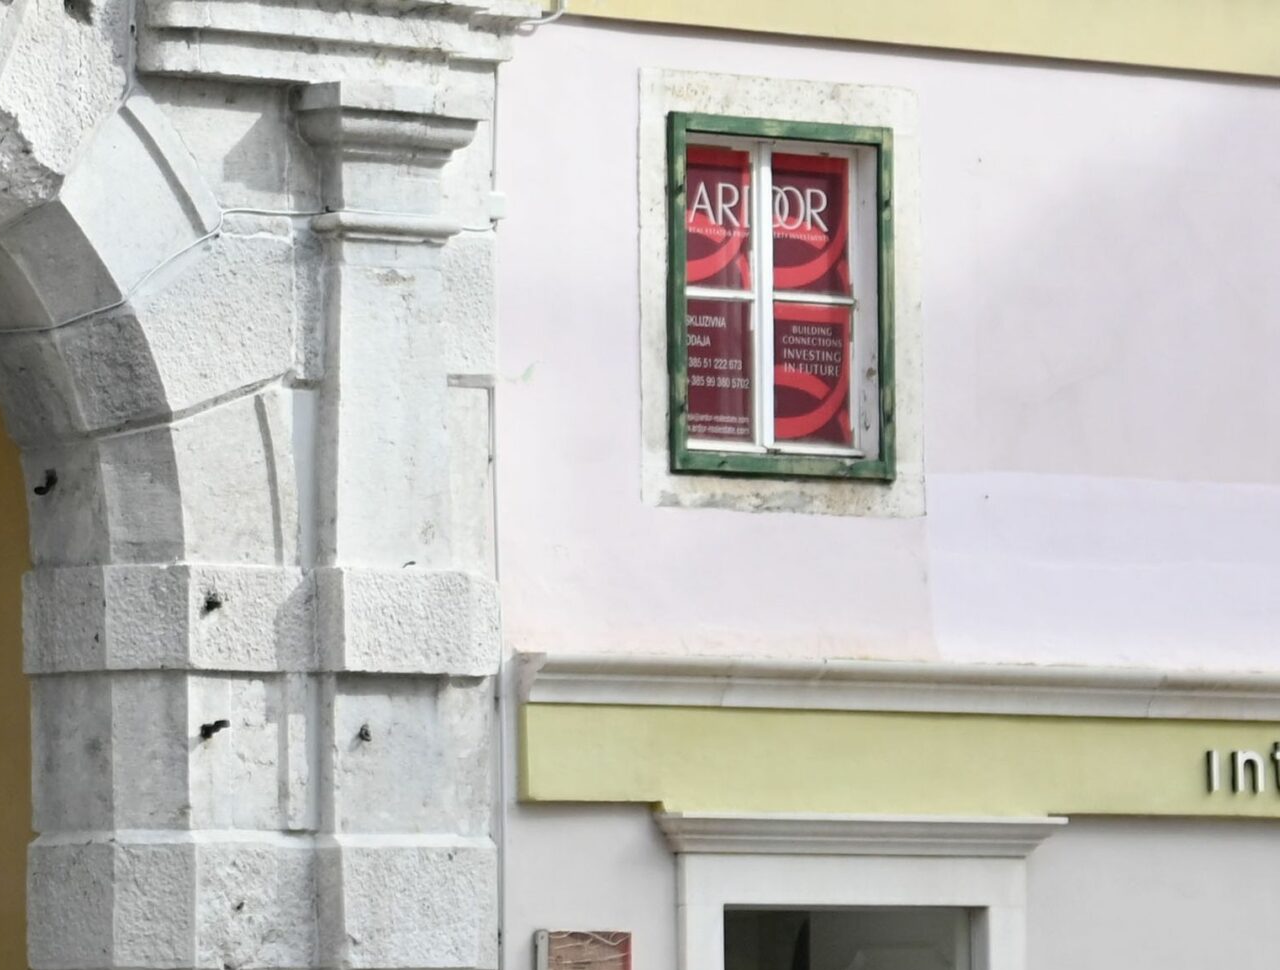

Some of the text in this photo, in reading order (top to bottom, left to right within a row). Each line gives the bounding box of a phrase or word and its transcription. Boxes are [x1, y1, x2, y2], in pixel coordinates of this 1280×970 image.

[792, 325, 833, 336] BUILDING
[782, 335, 842, 347] CONNECTIONS
[783, 348, 841, 363] INVESTING
[713, 358, 728, 370] 222
[783, 361, 839, 377] IN FUTURE
